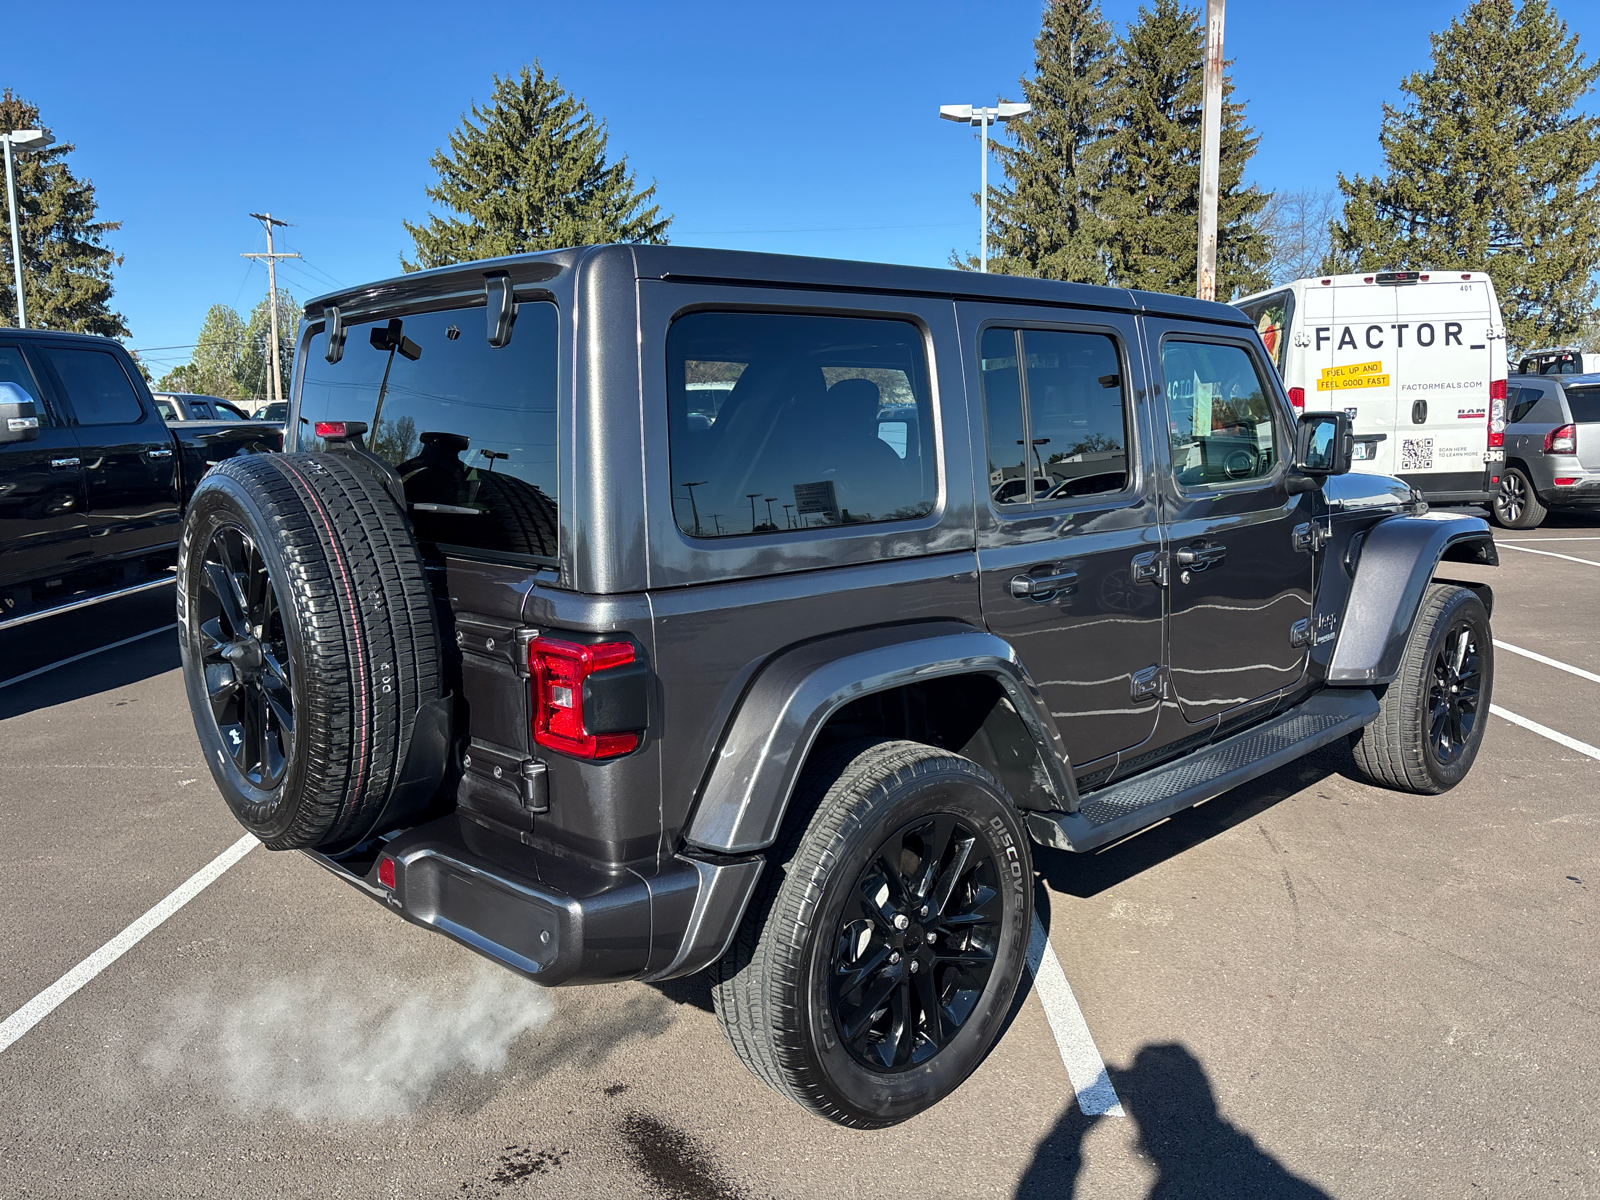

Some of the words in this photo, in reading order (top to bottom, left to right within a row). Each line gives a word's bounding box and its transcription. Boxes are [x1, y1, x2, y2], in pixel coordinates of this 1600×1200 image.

[1326, 369, 1345, 377] FUEL
[1348, 366, 1359, 374] UP
[1362, 364, 1378, 373] AND
[1342, 378, 1363, 387] GOOD
[1367, 377, 1386, 385] FAST
[1401, 381, 1483, 391] FACTORMEALS.COM
[989, 815, 1024, 968] DISCOVERER
